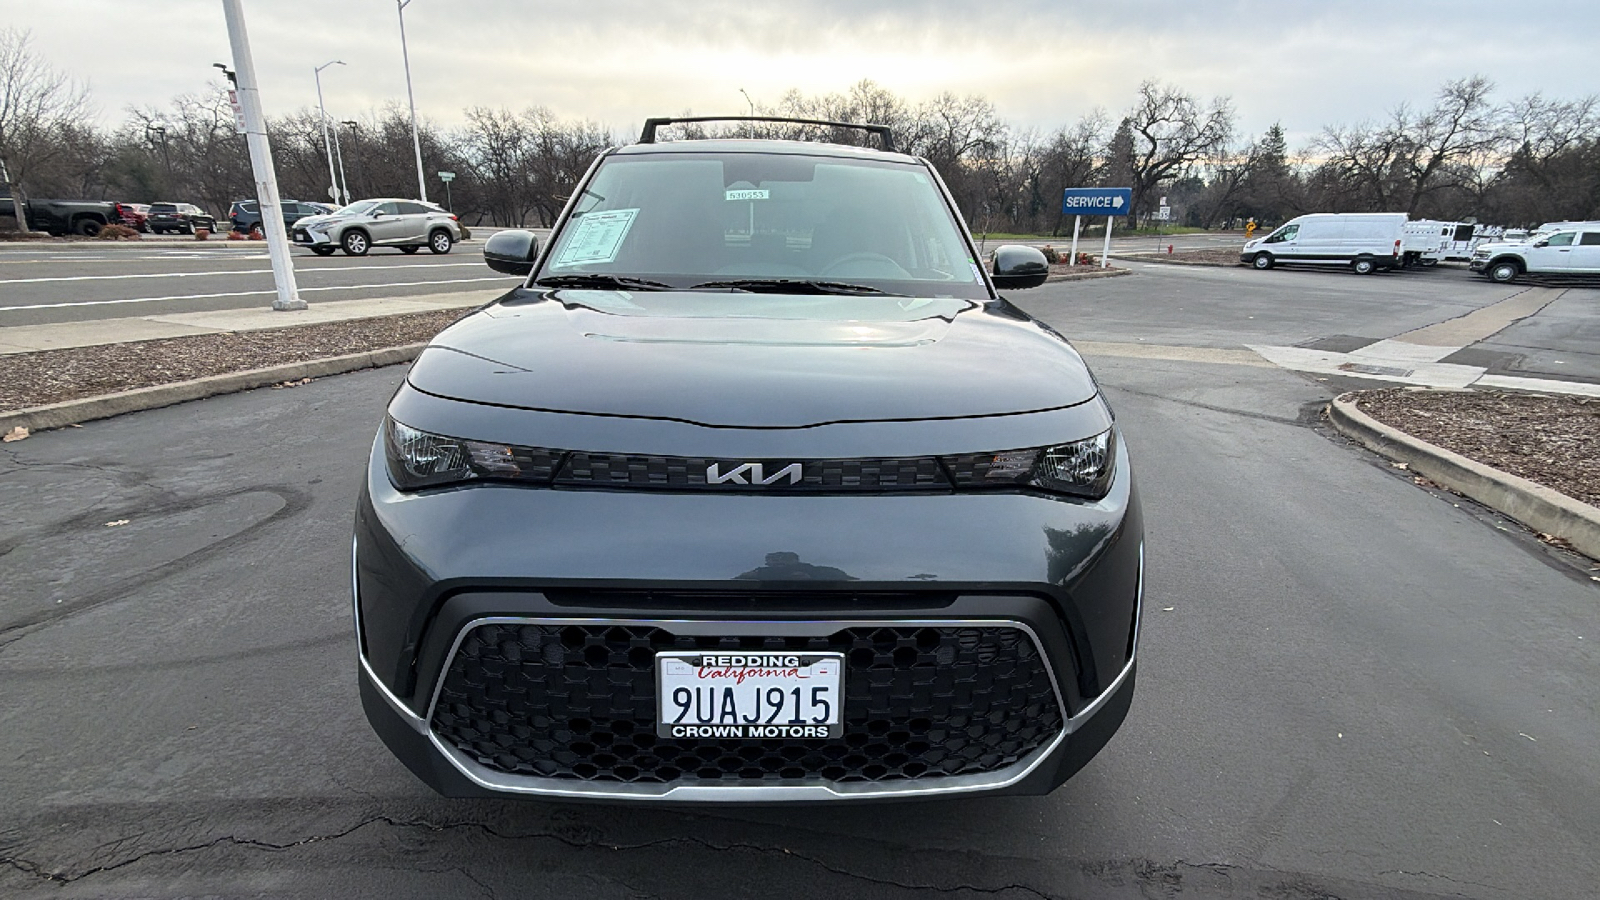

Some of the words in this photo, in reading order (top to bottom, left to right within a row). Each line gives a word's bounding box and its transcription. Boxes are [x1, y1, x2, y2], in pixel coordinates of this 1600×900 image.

[1066, 196, 1112, 208] SERVICE
[706, 462, 803, 485] KIA
[702, 655, 800, 667] REDDING
[698, 666, 811, 685] California
[672, 686, 831, 724] 9UAJ915
[672, 726, 742, 738] CROWN
[749, 726, 829, 738] MOTORS
